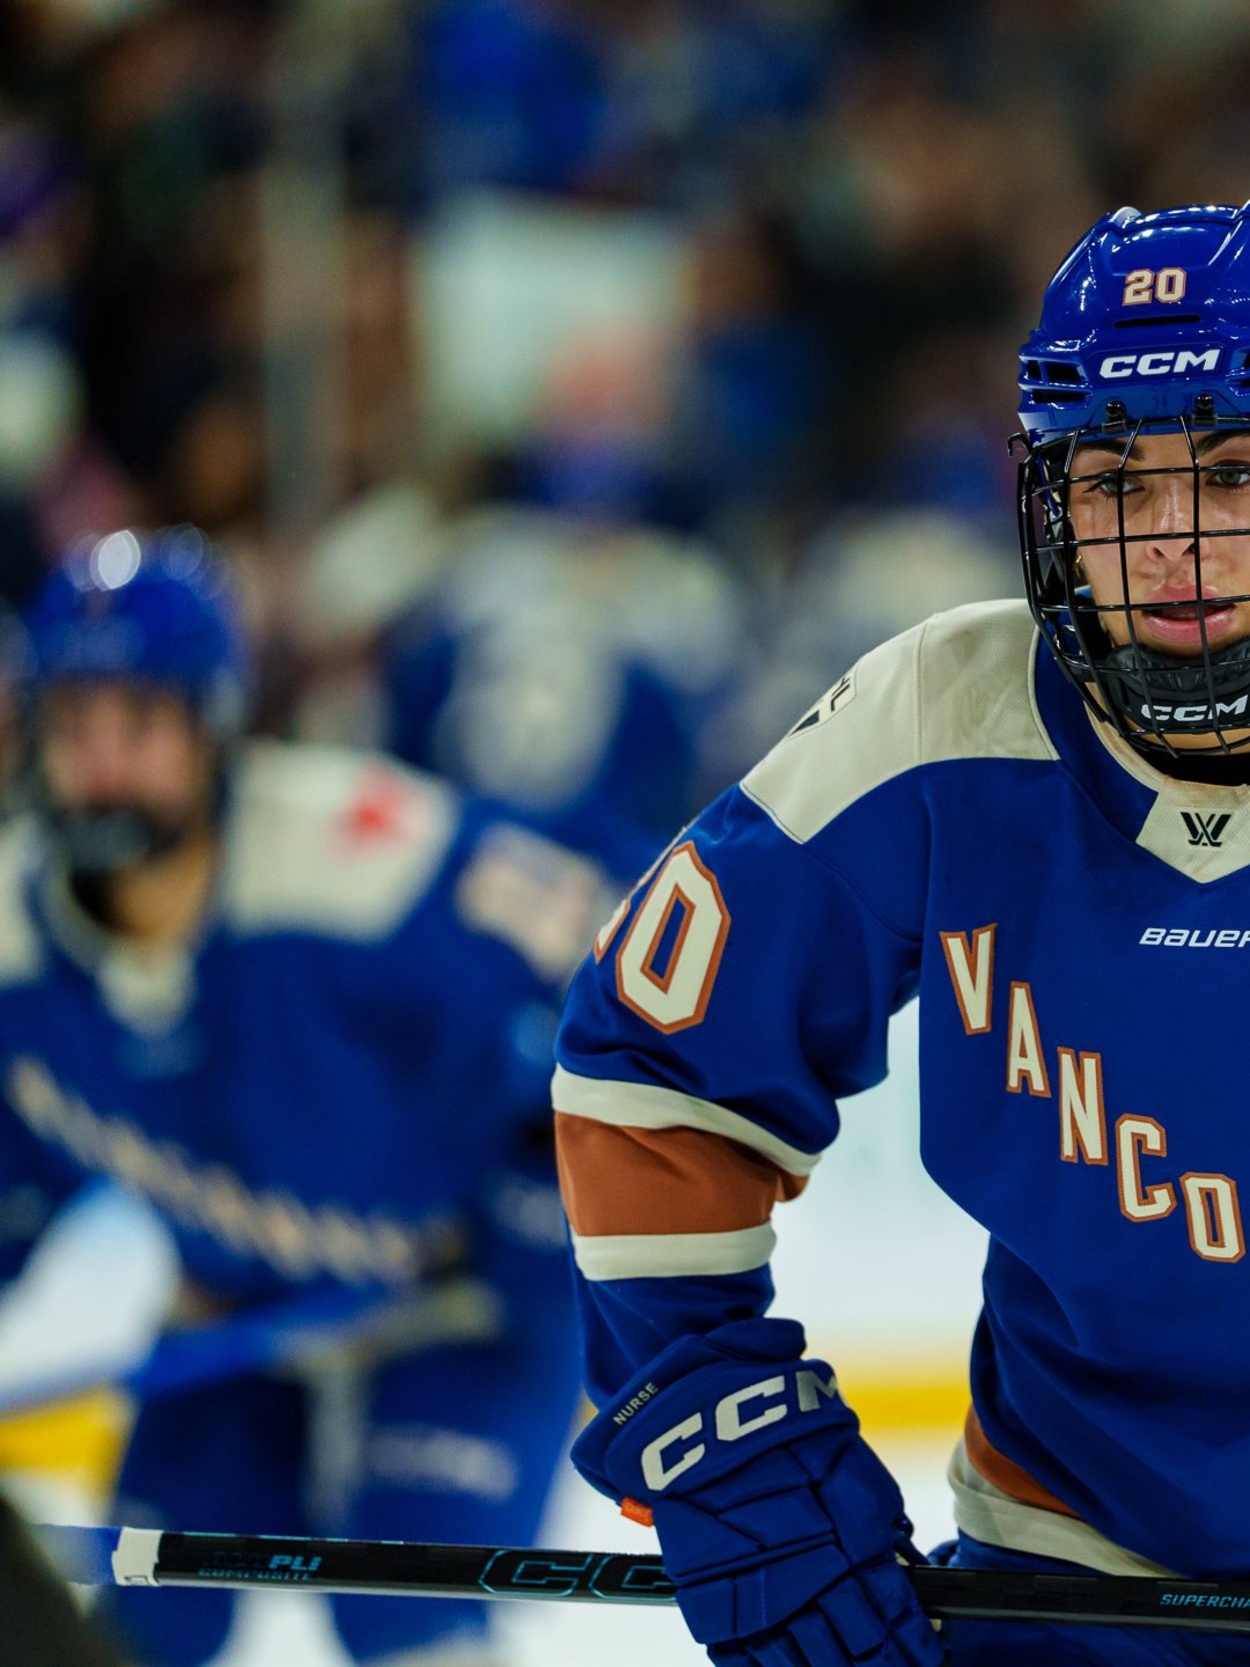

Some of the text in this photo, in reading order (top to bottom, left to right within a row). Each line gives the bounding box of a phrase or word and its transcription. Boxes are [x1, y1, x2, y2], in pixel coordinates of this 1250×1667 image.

[1122, 266, 1187, 306] 20
[1100, 349, 1221, 379] CCM
[1141, 695, 1249, 721] CCM
[593, 826, 732, 1035] 0
[613, 1382, 660, 1425] NURSE
